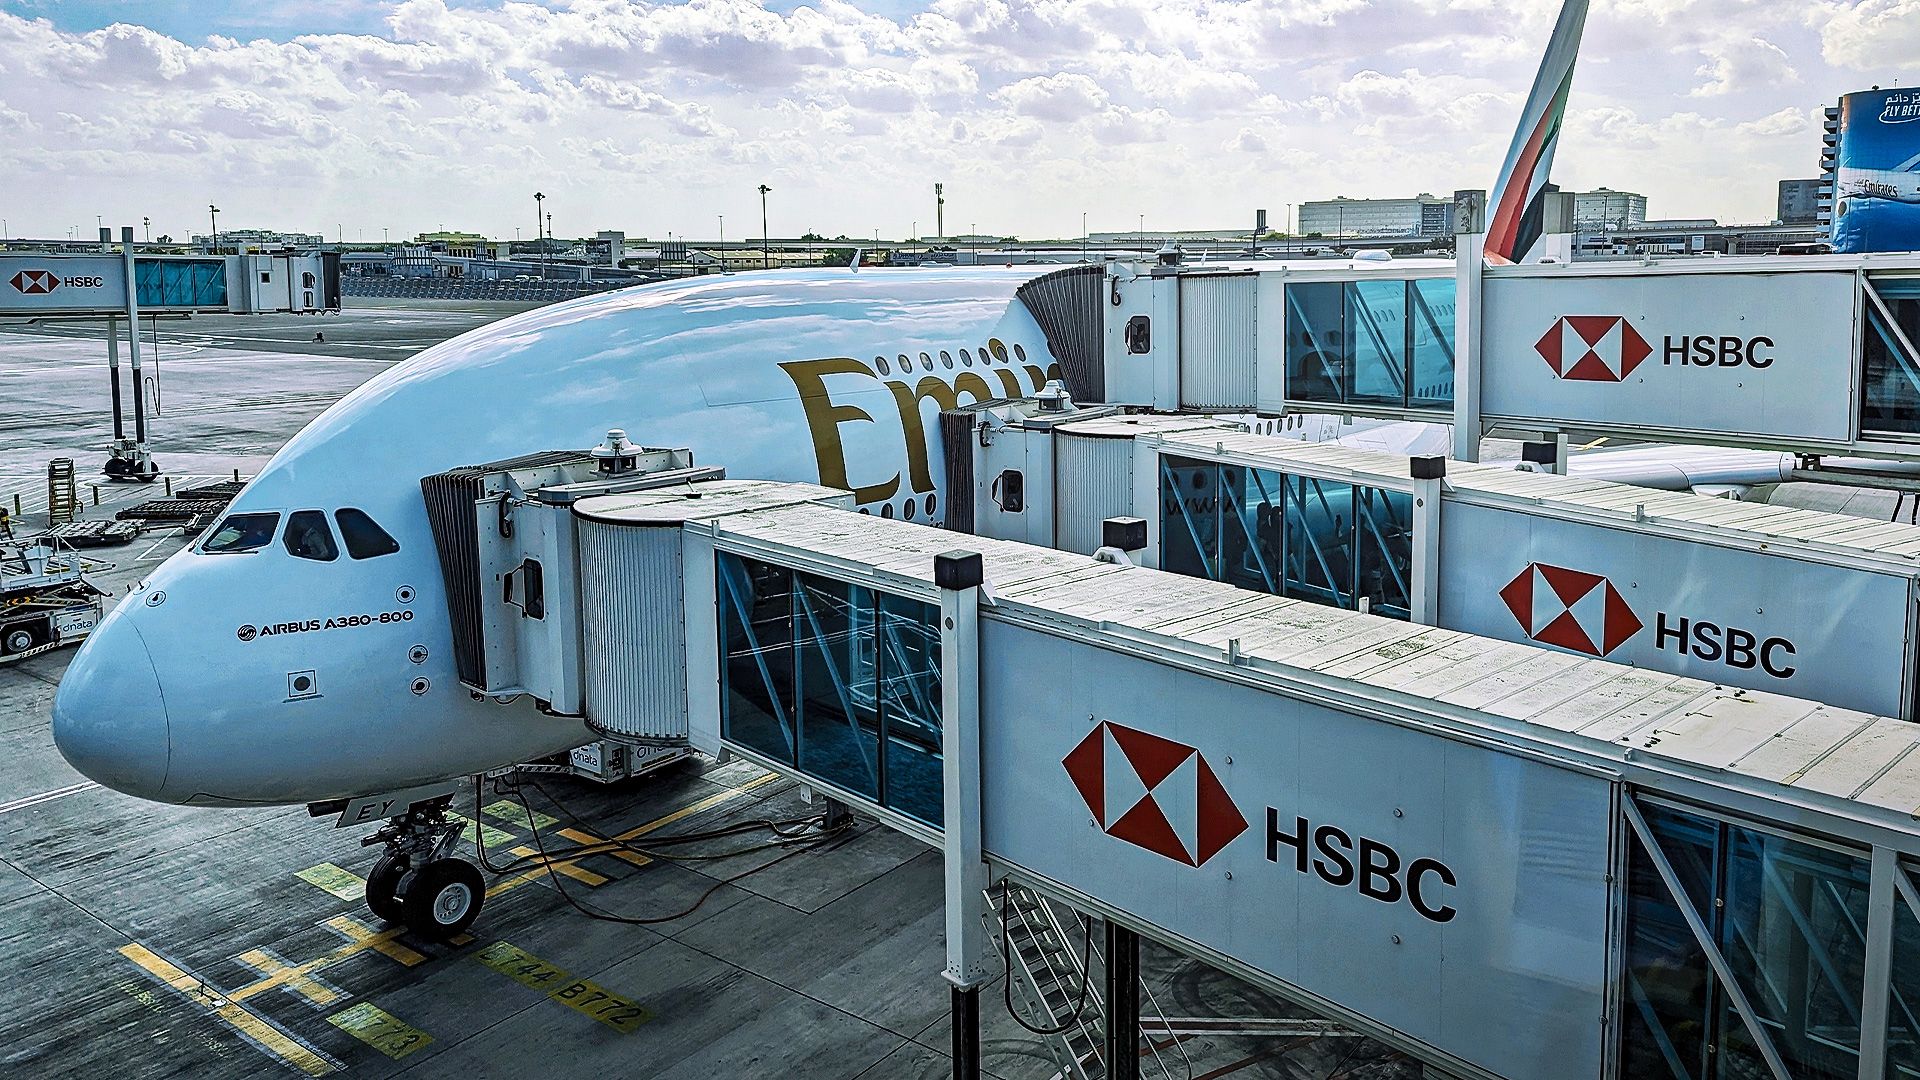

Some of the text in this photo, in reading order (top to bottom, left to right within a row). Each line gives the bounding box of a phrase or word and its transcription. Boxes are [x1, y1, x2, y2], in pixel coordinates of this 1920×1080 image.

[1884, 105, 1900, 118] FLY
[1864, 179, 1898, 198] Emirates
[63, 276, 104, 288] HSBC
[1662, 334, 1776, 369] HSBC
[62, 619, 93, 632] dnata
[259, 610, 414, 637] AIRBUS A380-800
[1655, 610, 1797, 680] HSBC
[573, 751, 598, 767] dnata
[355, 799, 396, 821] EY
[1265, 805, 1458, 924] HSBC
[557, 982, 643, 1026] B772
